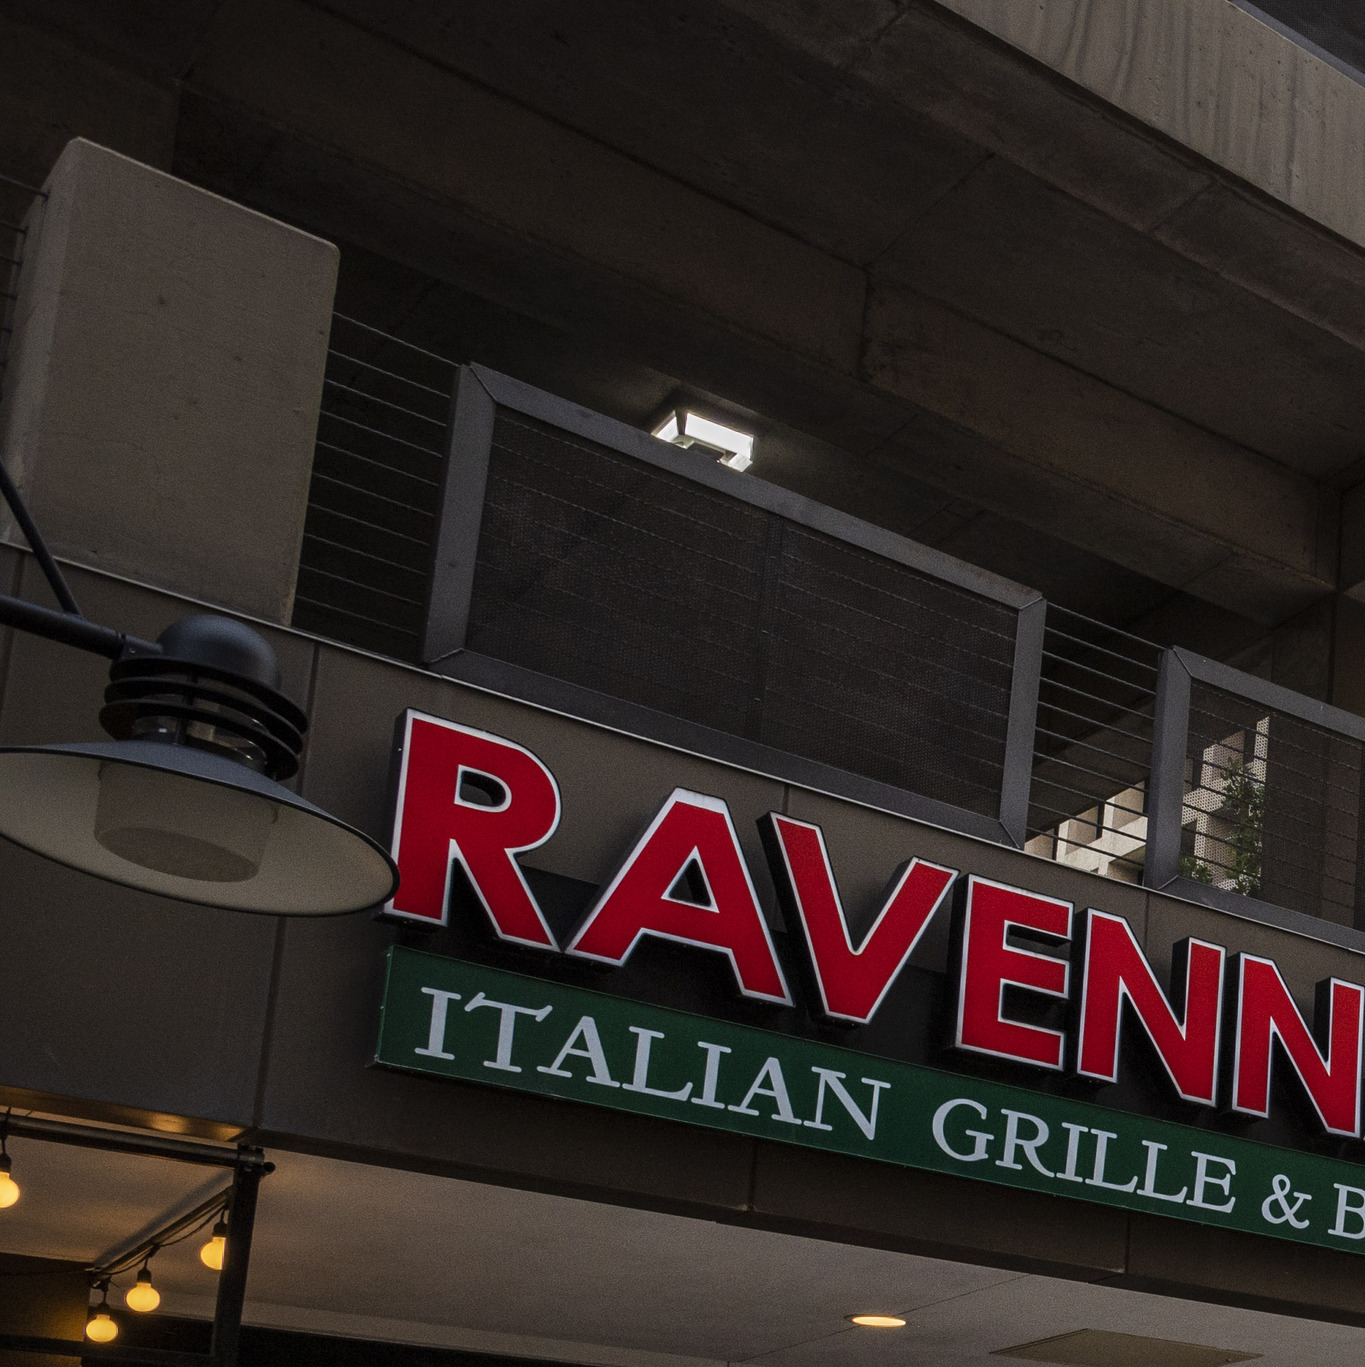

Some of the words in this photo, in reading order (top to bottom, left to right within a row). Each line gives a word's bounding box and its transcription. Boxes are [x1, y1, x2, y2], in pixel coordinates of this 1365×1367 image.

[414, 986, 891, 1140] ITALIAN
[931, 1097, 1238, 1215] GRILLE
[1260, 1173, 1312, 1230] &
